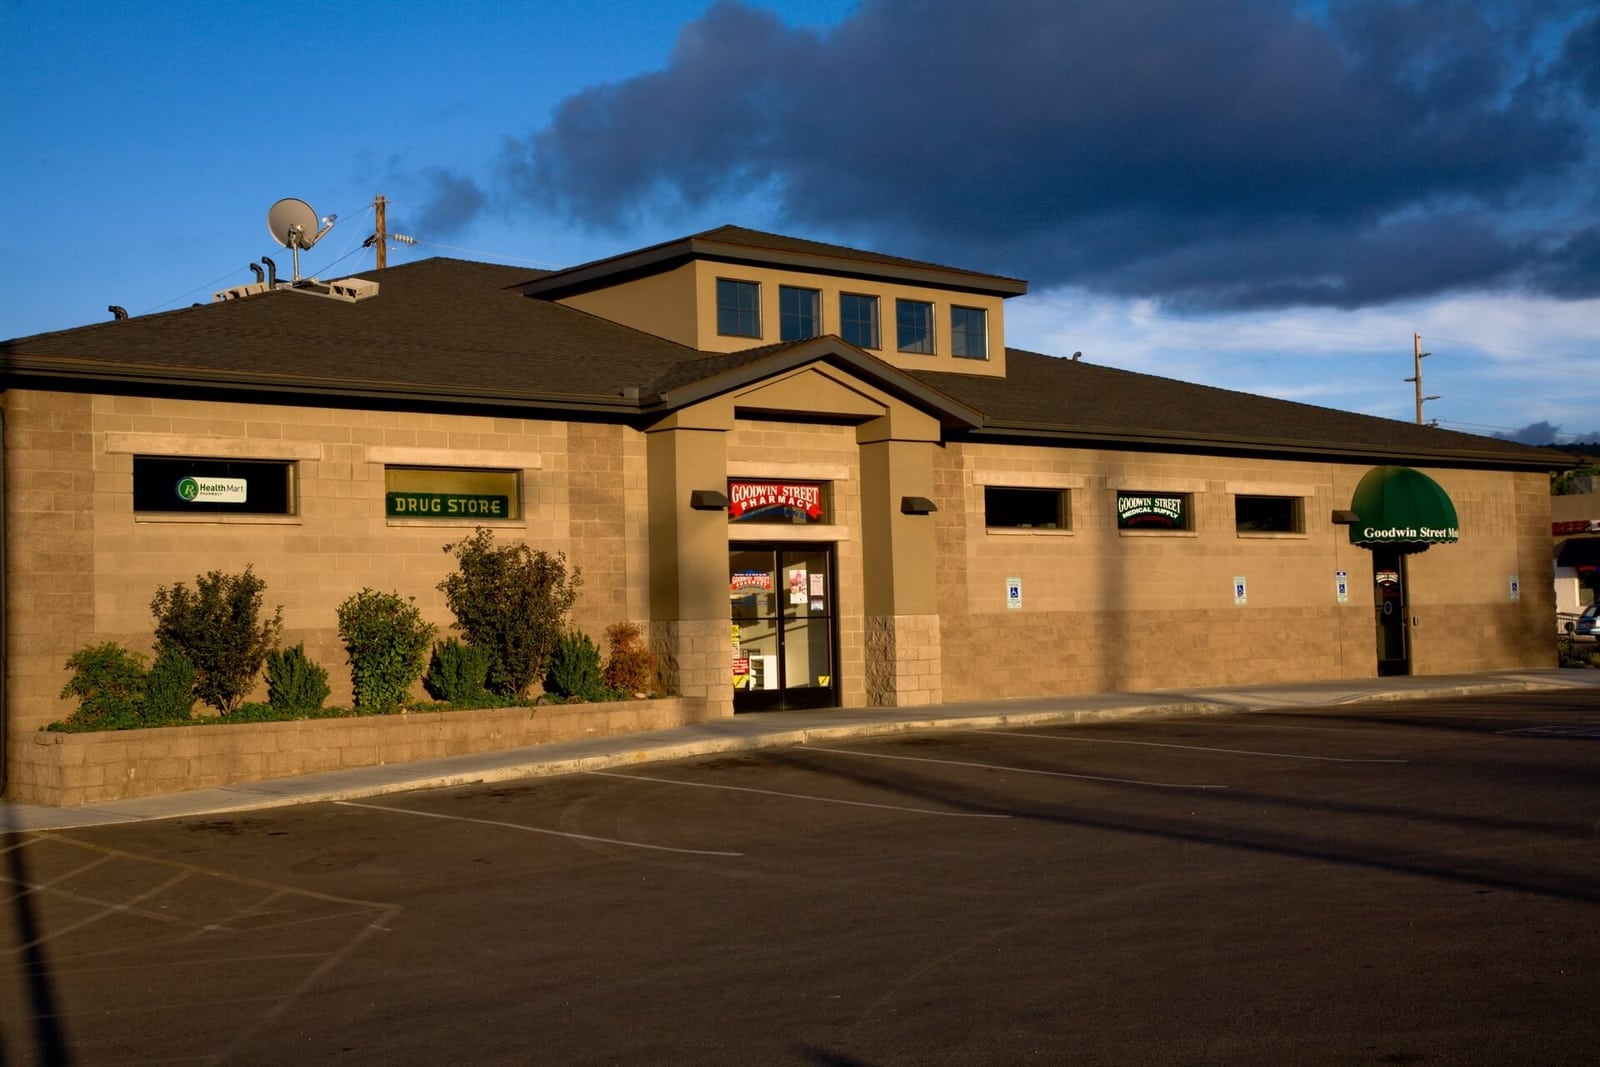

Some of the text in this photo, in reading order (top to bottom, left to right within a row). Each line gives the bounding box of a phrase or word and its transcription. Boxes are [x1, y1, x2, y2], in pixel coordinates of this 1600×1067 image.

[200, 484, 244, 493] Health Mart
[732, 484, 819, 505] GOODWIN STREET
[395, 498, 501, 514] DRUG STORE
[741, 495, 812, 511] PHARMACY
[1118, 497, 1181, 513] GOODWIN STREET
[1122, 507, 1179, 519] MEDICAL SUPPLY
[1364, 527, 1417, 538] Goodwin
[1420, 527, 1446, 538] Street
